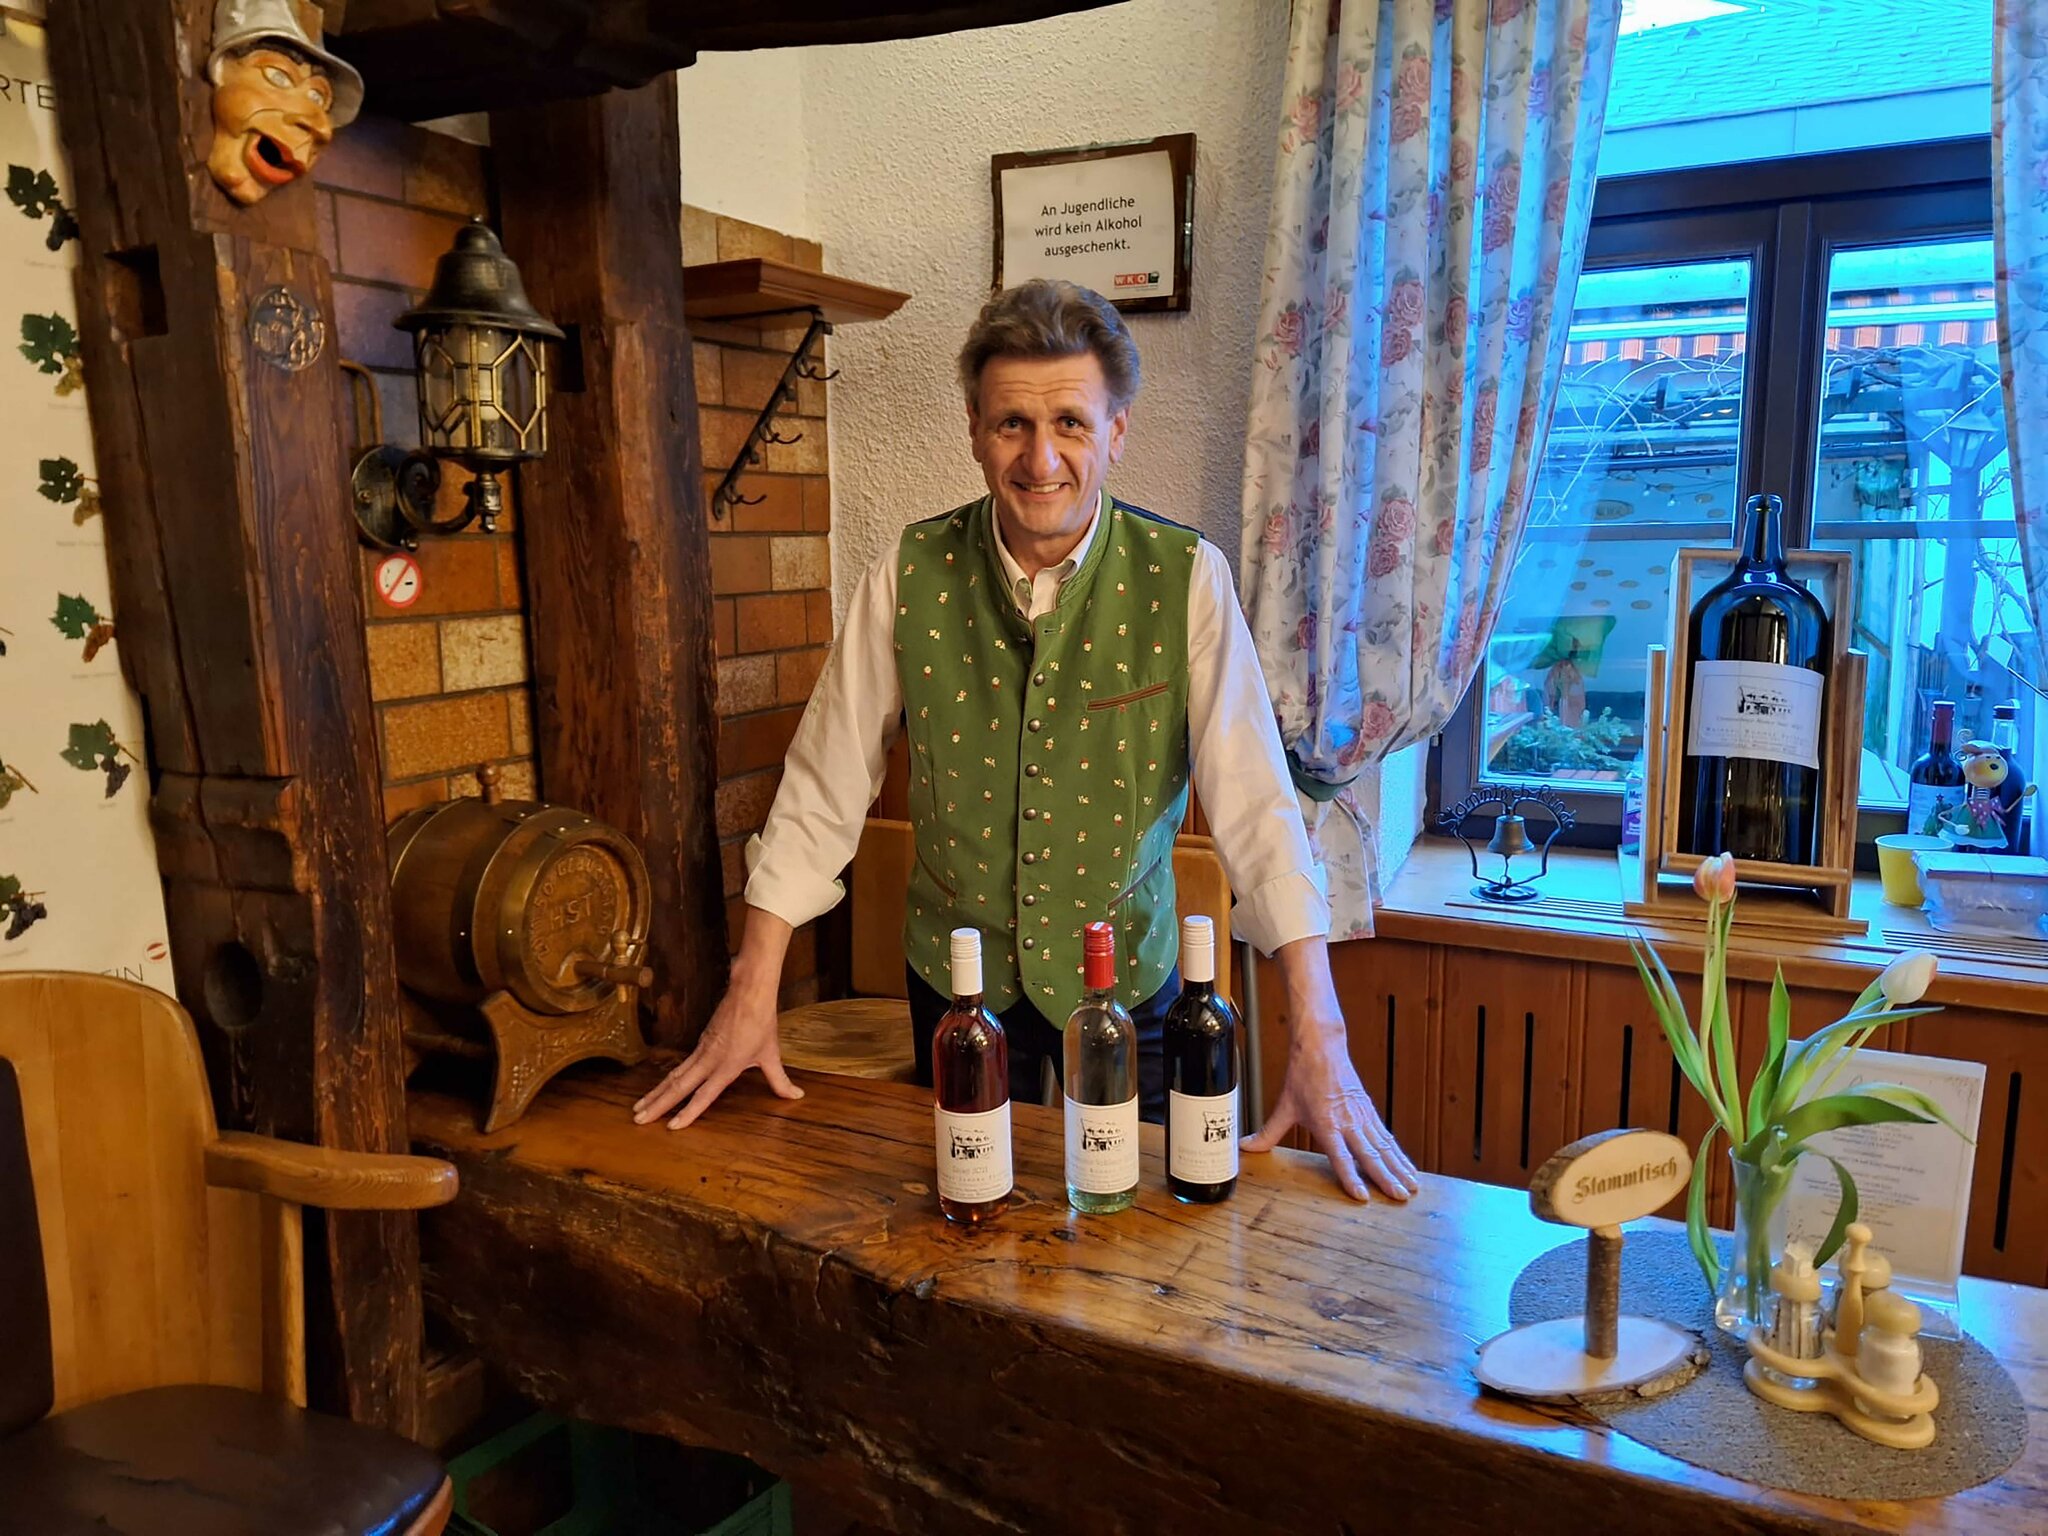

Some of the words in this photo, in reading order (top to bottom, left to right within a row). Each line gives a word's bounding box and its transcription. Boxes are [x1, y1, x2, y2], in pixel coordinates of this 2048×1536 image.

[1040, 204, 1057, 217] An
[1060, 196, 1135, 216] Jugendliche
[1034, 223, 1062, 238] wird
[1065, 221, 1092, 235] kein
[1095, 215, 1142, 233] Alkohol
[1044, 238, 1131, 257] ausgeschenkt.
[1115, 274, 1146, 285] WKO
[1572, 1156, 1678, 1204] Stammtisch
